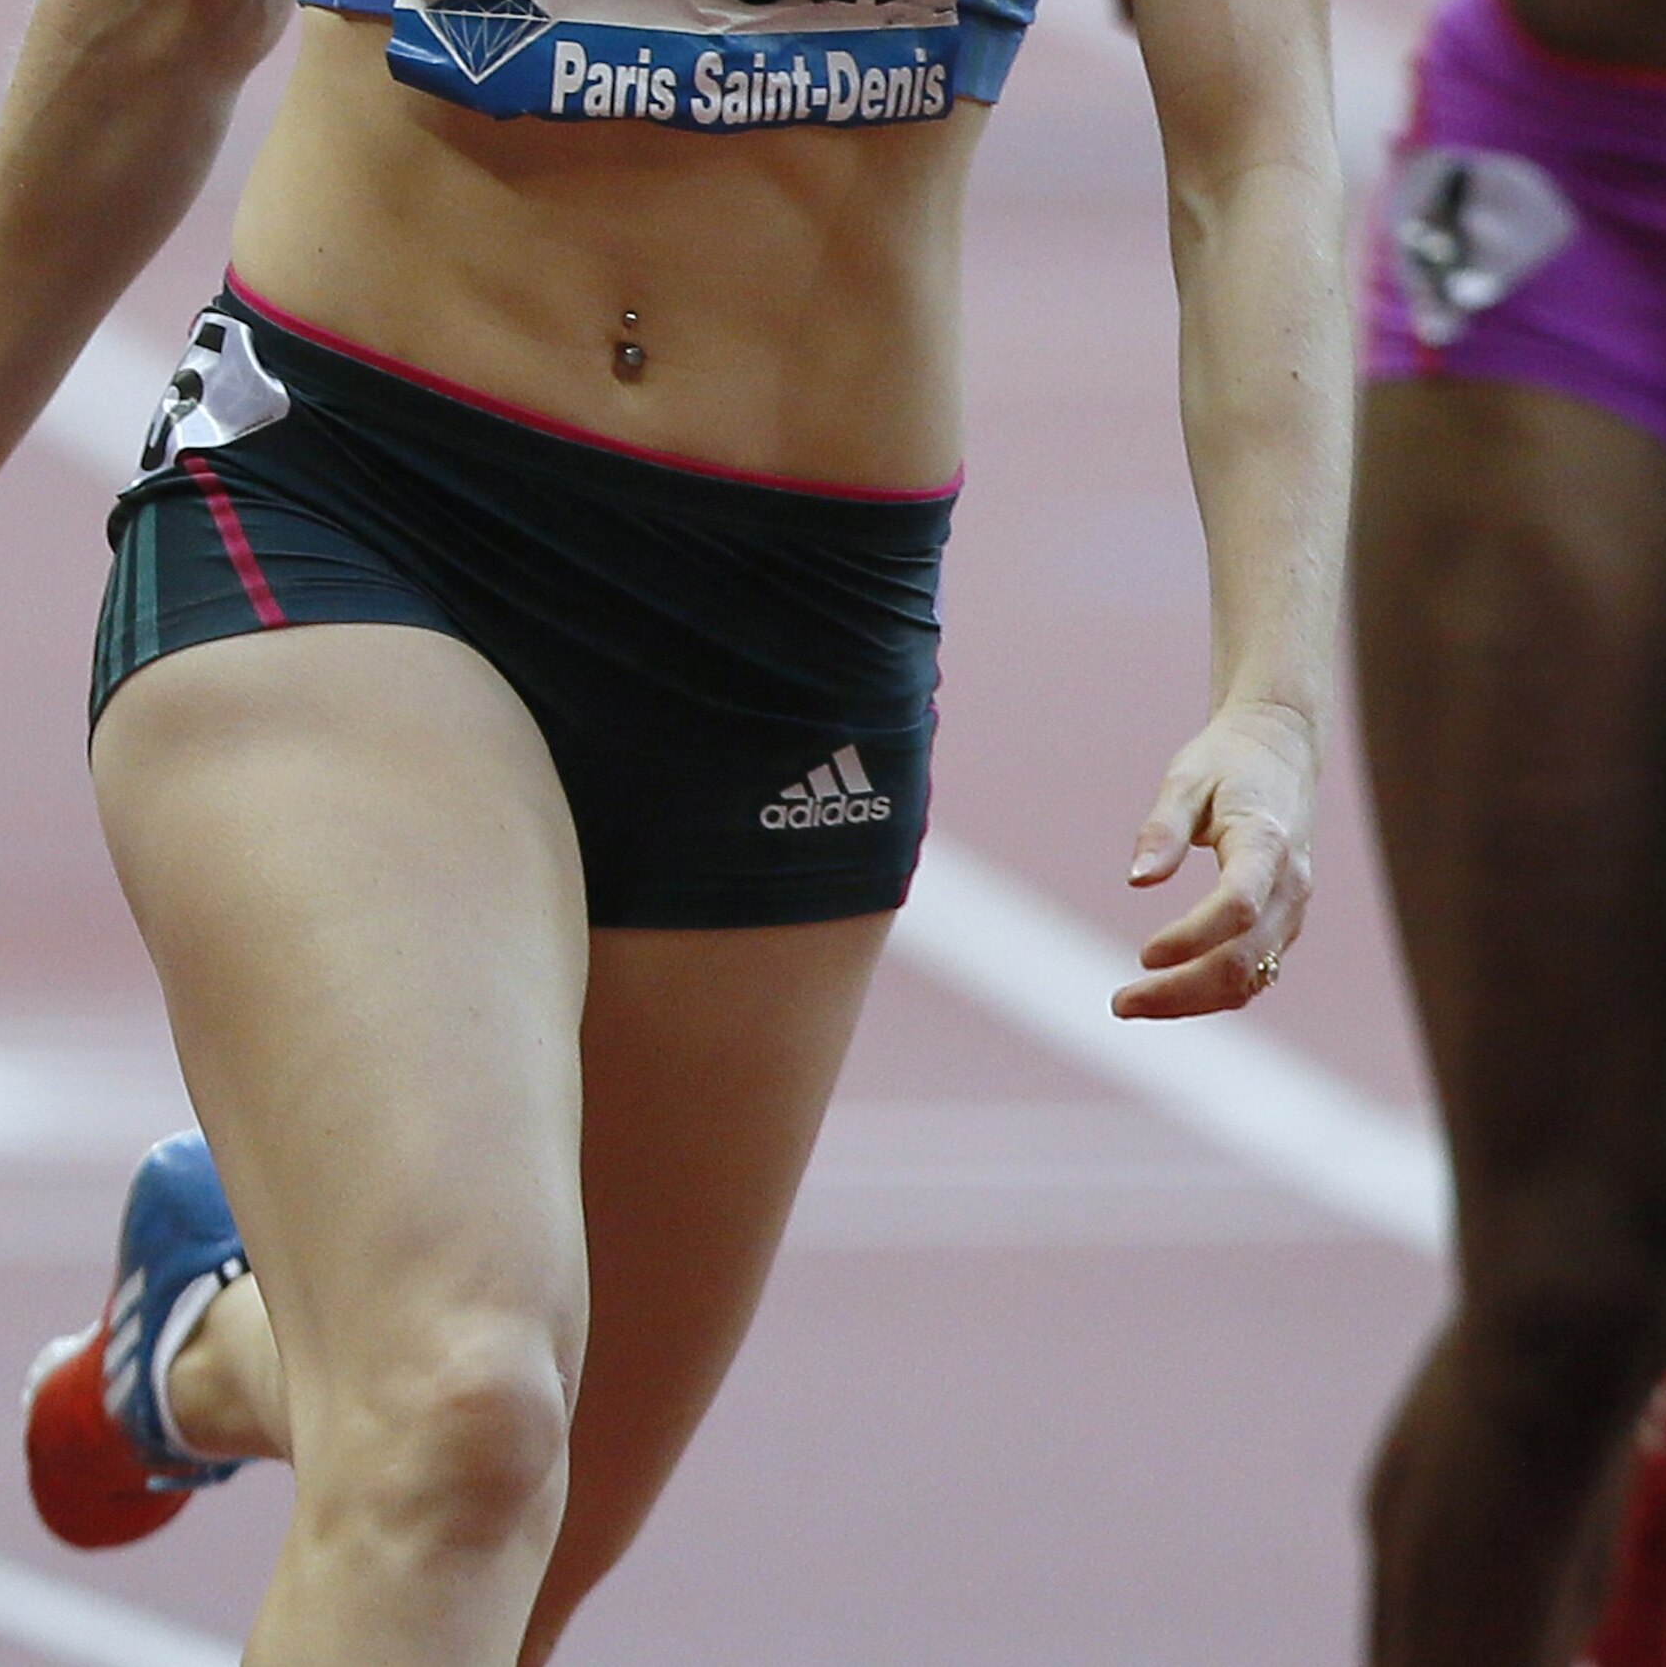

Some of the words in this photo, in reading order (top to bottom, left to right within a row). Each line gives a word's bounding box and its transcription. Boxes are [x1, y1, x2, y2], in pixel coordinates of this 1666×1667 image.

[551, 40, 677, 120] Paris
[690, 48, 947, 124] Saint-Denis
[759, 794, 891, 829] adidas
